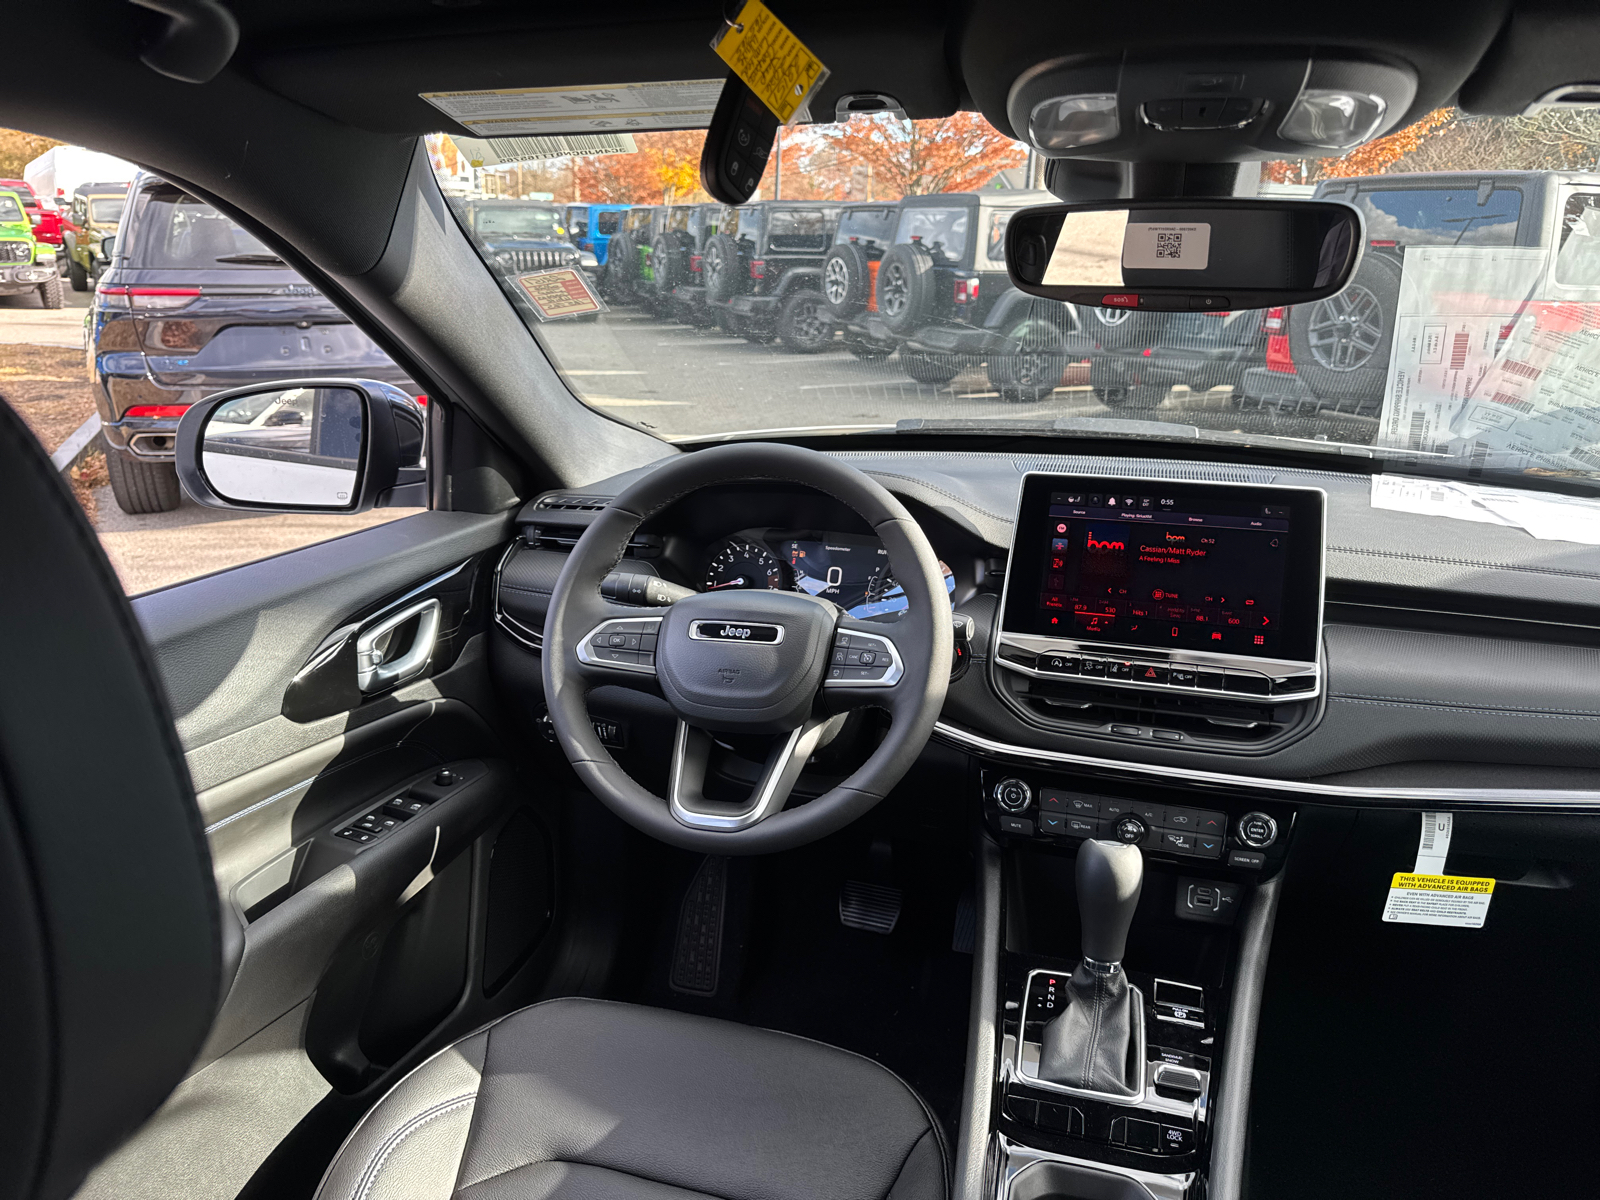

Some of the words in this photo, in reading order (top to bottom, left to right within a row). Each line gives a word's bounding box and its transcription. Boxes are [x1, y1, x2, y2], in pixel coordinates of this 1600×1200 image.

[275, 397, 298, 405] Jeep
[1166, 532, 1185, 544] bpm
[1140, 545, 1185, 555] Cassian/Matt
[1186, 549, 1206, 557] Ryder
[827, 567, 842, 587] 0
[720, 625, 751, 639] Jeep
[1167, 1134, 1183, 1142] LOCK
